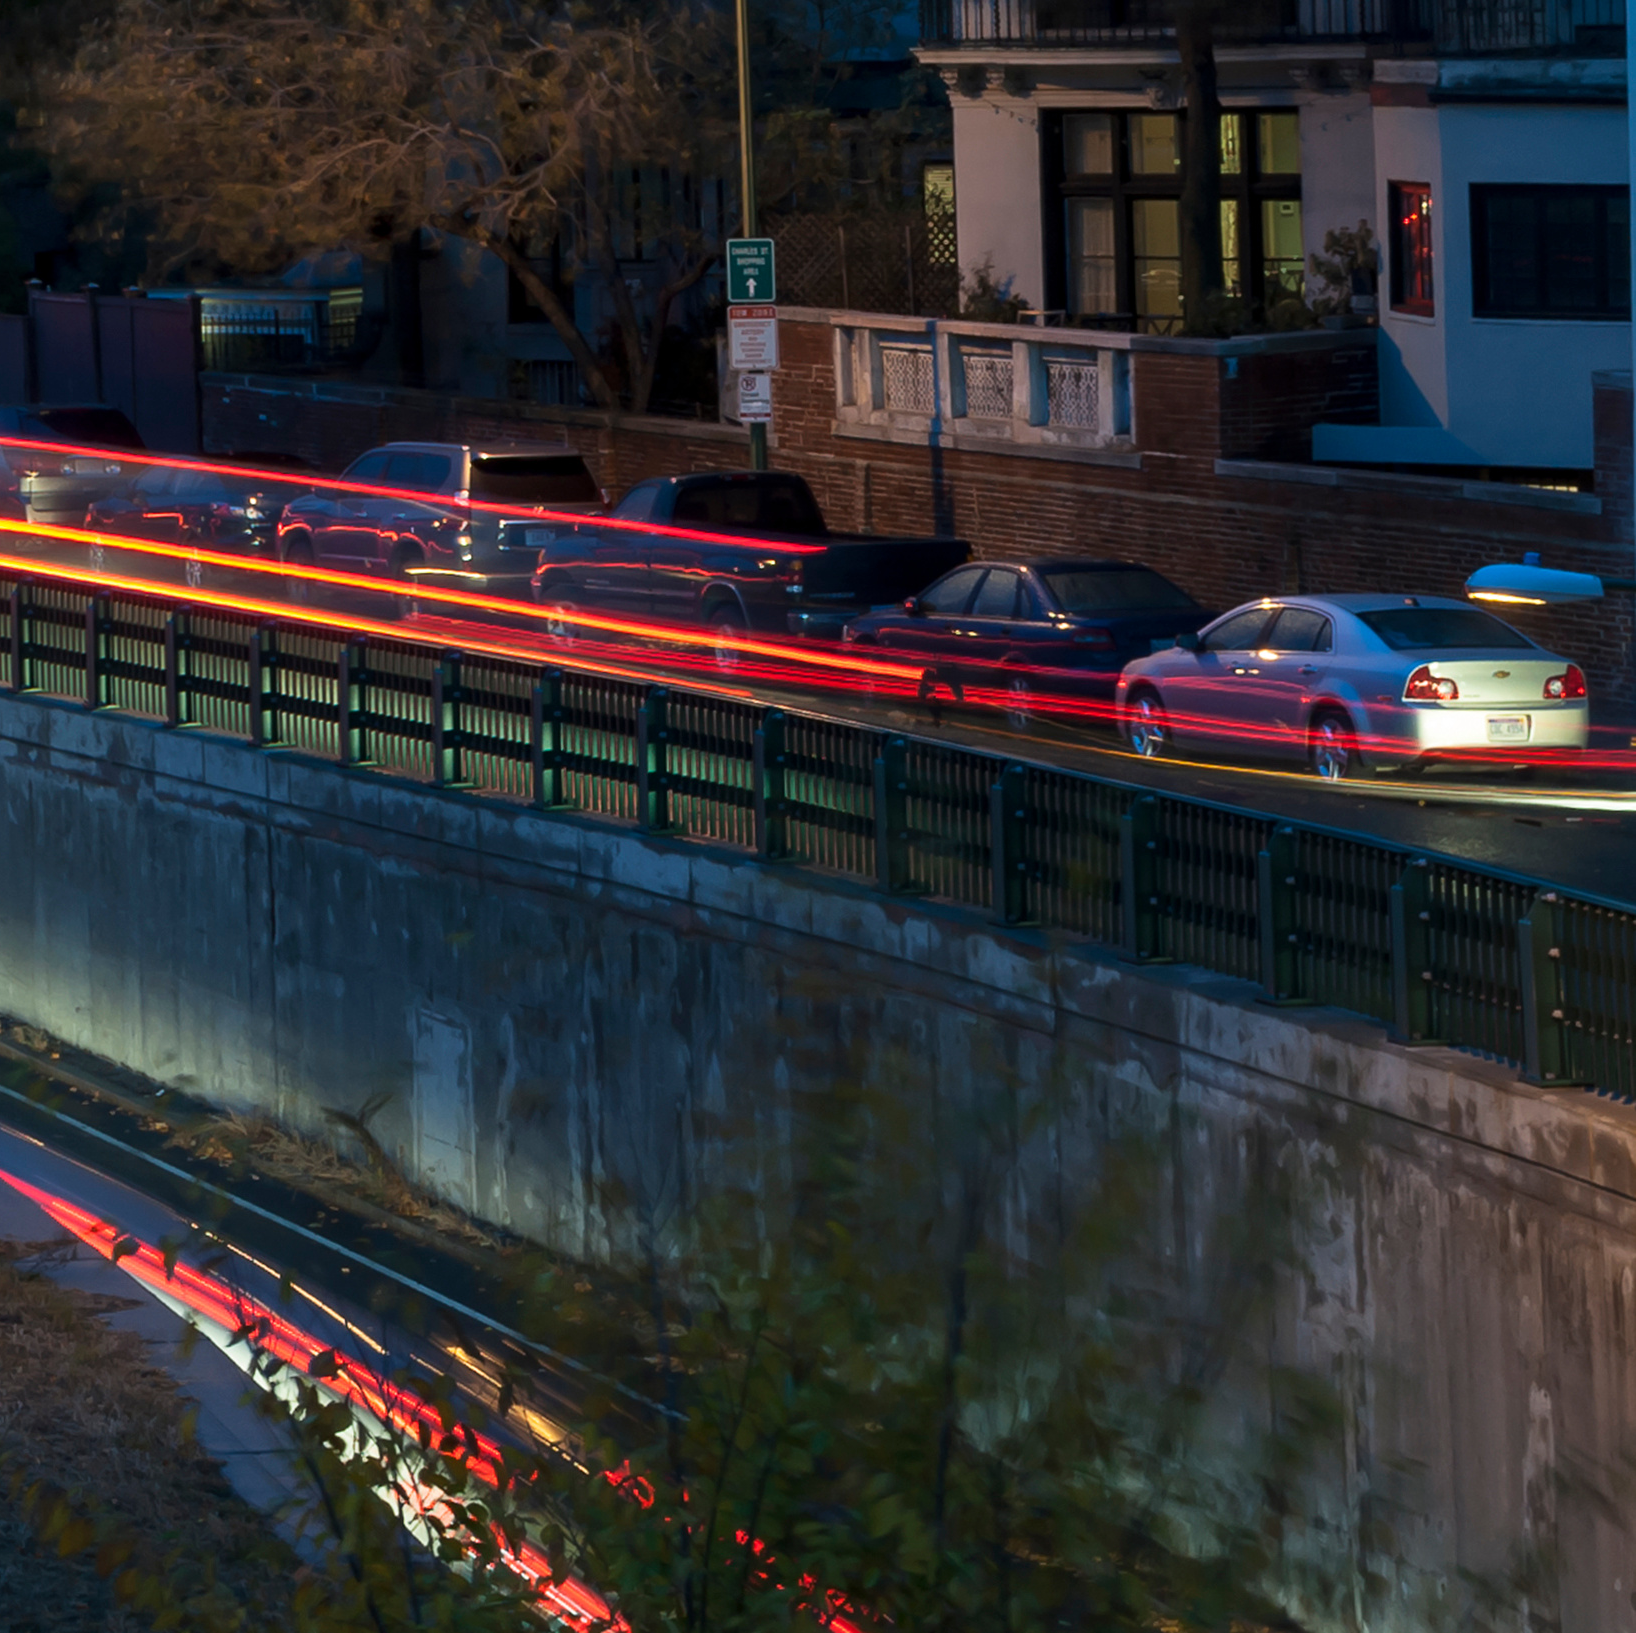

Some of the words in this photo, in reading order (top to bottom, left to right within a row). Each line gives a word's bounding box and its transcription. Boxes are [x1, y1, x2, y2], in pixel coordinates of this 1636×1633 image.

[732, 247, 758, 255] CHARLES
[737, 257, 765, 266] SHOPPING
[743, 267, 759, 275] AREA
[732, 309, 747, 317] TOW
[752, 308, 774, 317] ZONE
